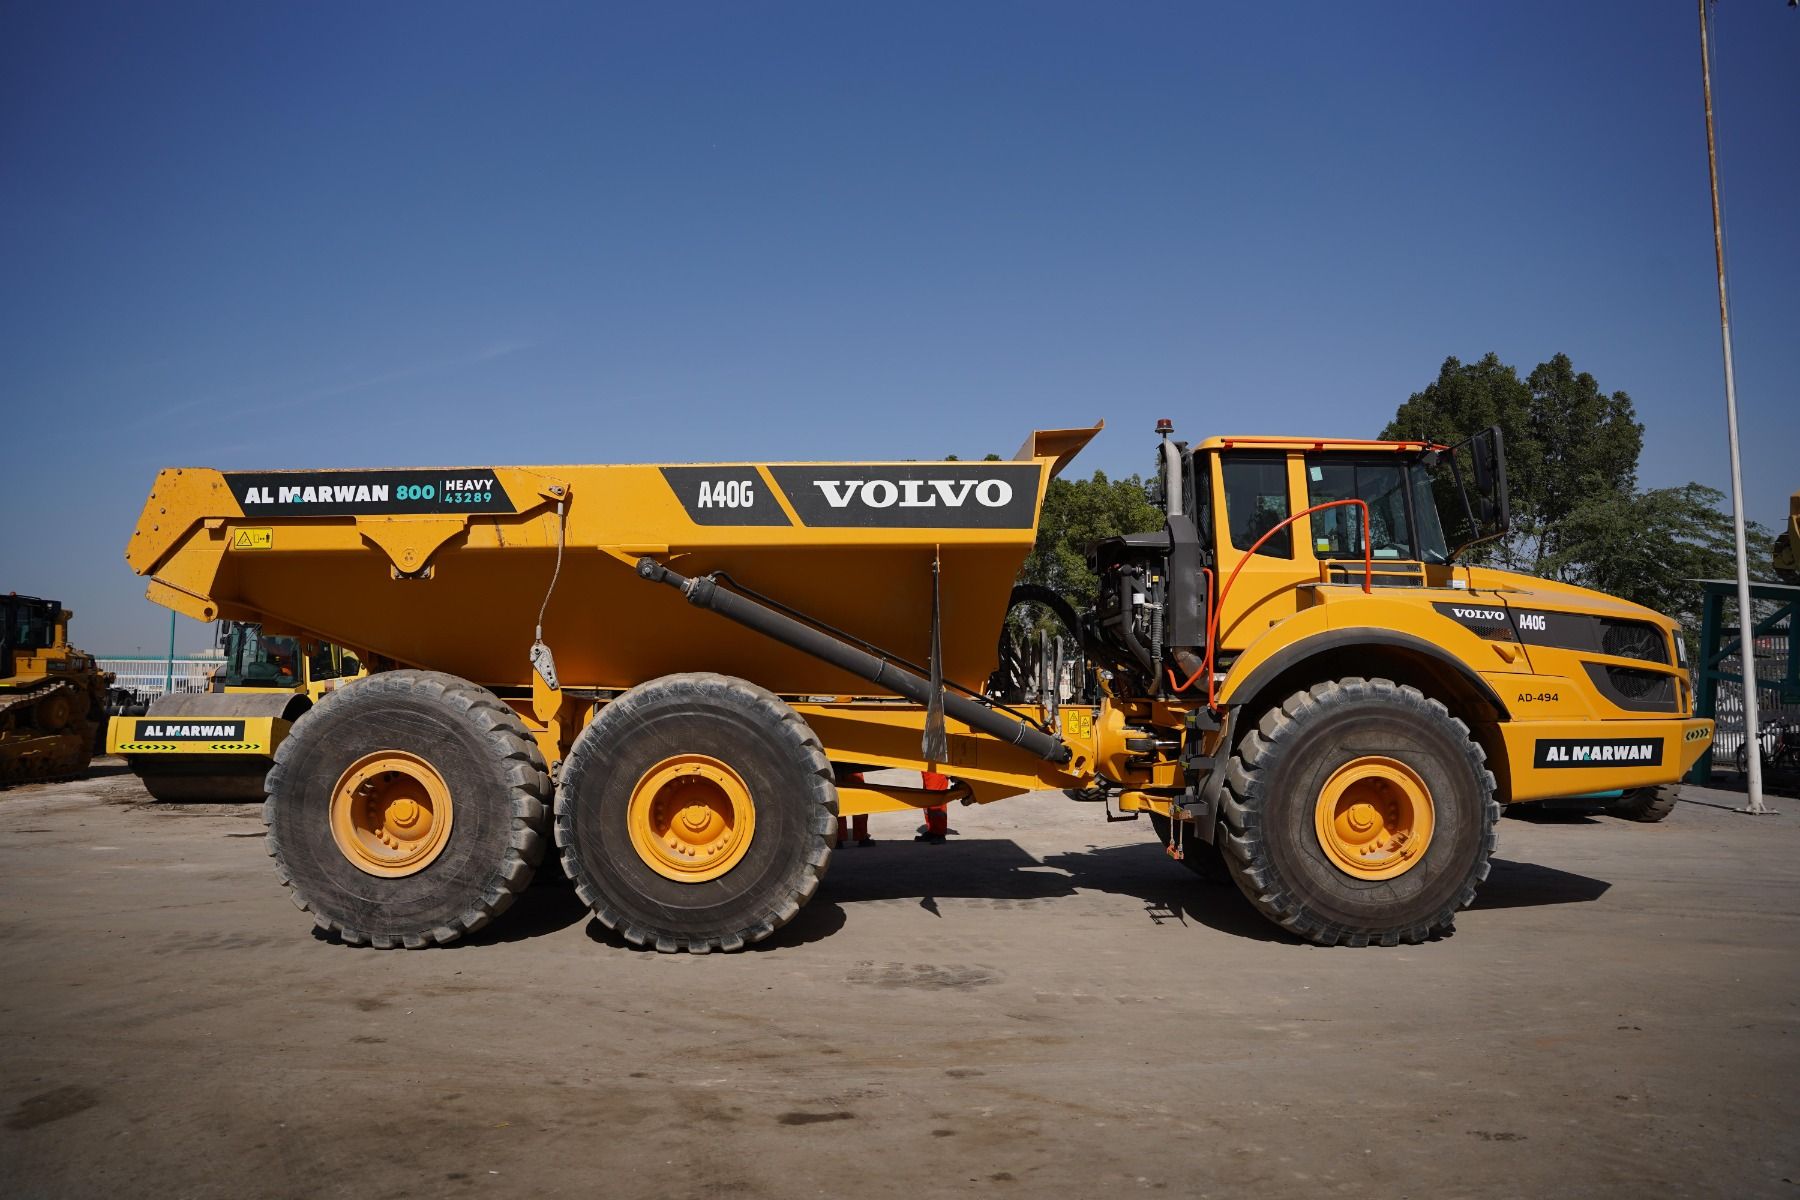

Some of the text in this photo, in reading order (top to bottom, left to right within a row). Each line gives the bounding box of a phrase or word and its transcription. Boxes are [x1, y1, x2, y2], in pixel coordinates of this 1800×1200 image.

[396, 484, 435, 501] 800
[445, 479, 494, 491] HEAVY
[812, 479, 1014, 508] VOLVO
[244, 484, 389, 504] AL MARWAN
[444, 491, 493, 504] 43289
[697, 480, 754, 508] A40G
[1451, 608, 1505, 621] VOLVO
[1519, 613, 1546, 631] A40G
[1517, 693, 1559, 703] AD-494
[144, 725, 236, 737] AL MARWAN
[1546, 744, 1653, 762] AL MARWAN
